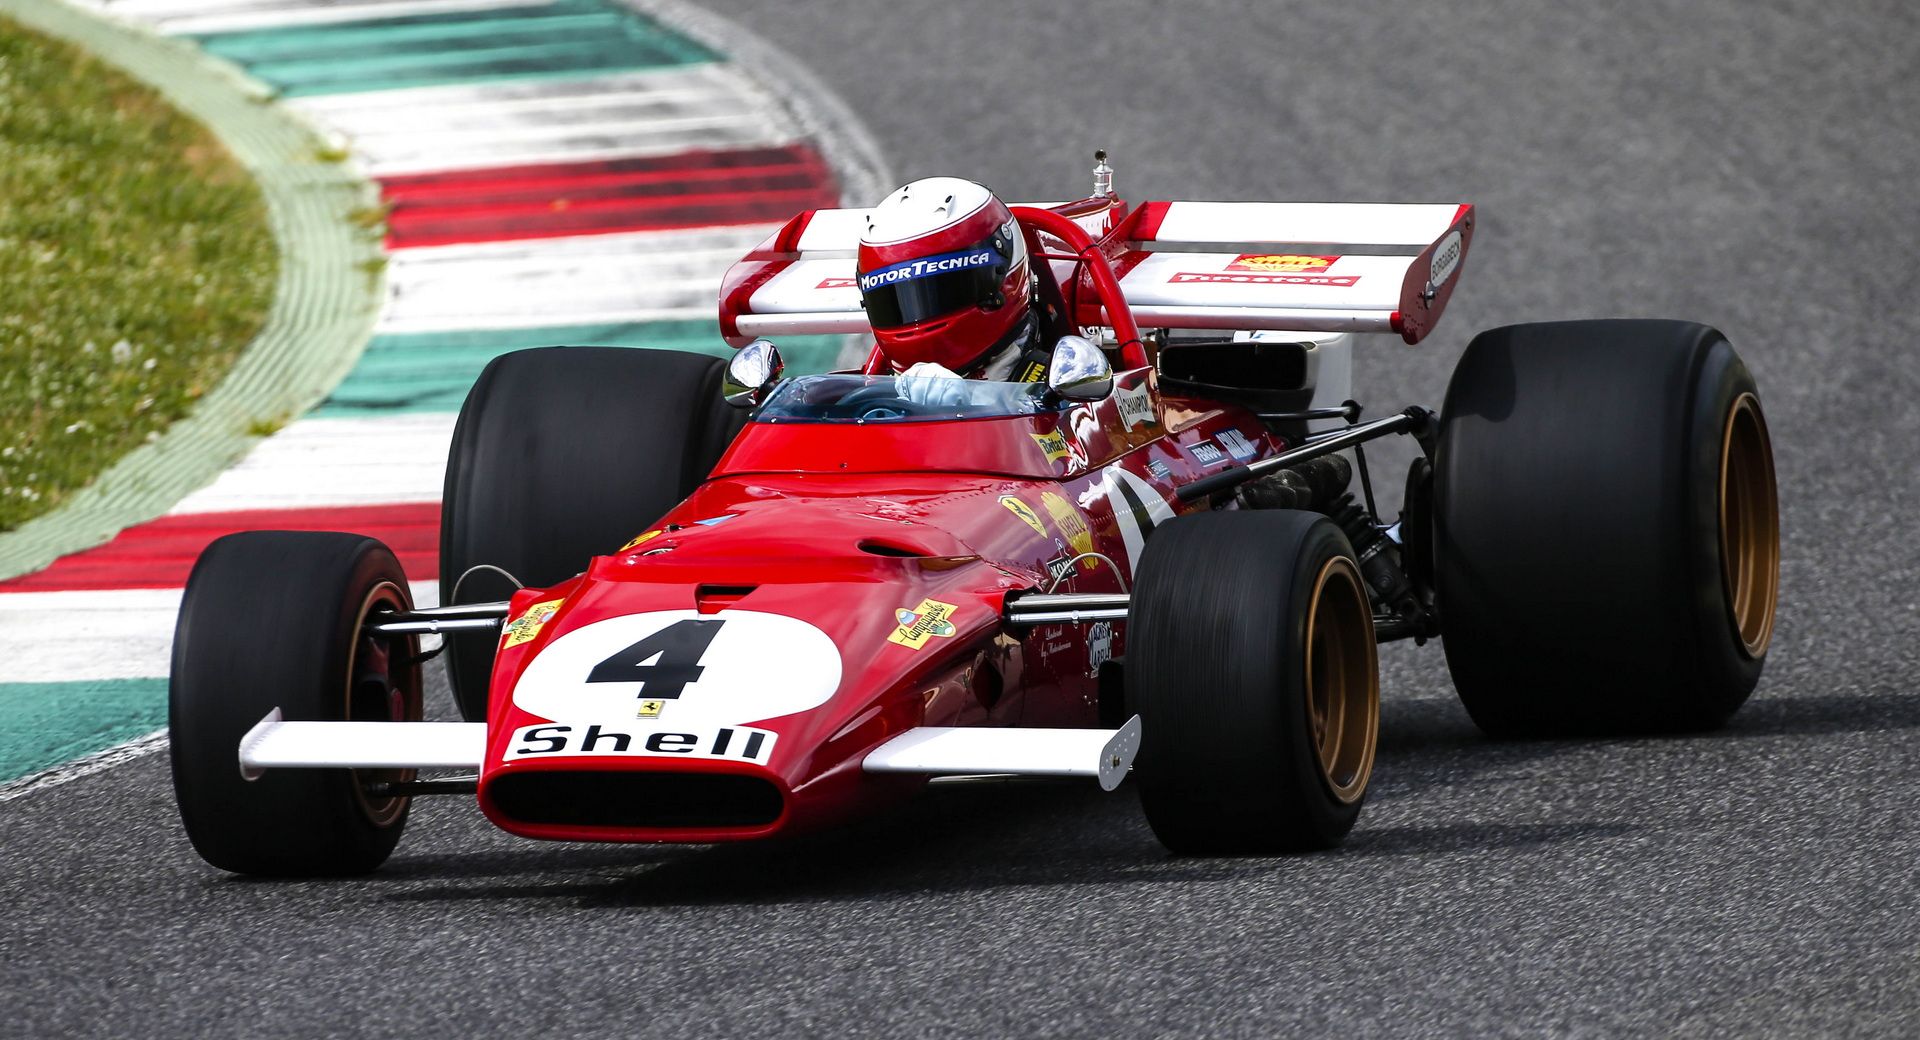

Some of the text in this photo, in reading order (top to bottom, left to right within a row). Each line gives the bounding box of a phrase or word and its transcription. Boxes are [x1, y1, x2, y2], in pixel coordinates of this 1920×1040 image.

[1178, 274, 1353, 285] Firestone
[1191, 443, 1221, 462] FERODO
[1058, 513, 1086, 539] SHELL
[585, 619, 726, 699] 4
[517, 725, 765, 759] Shell
